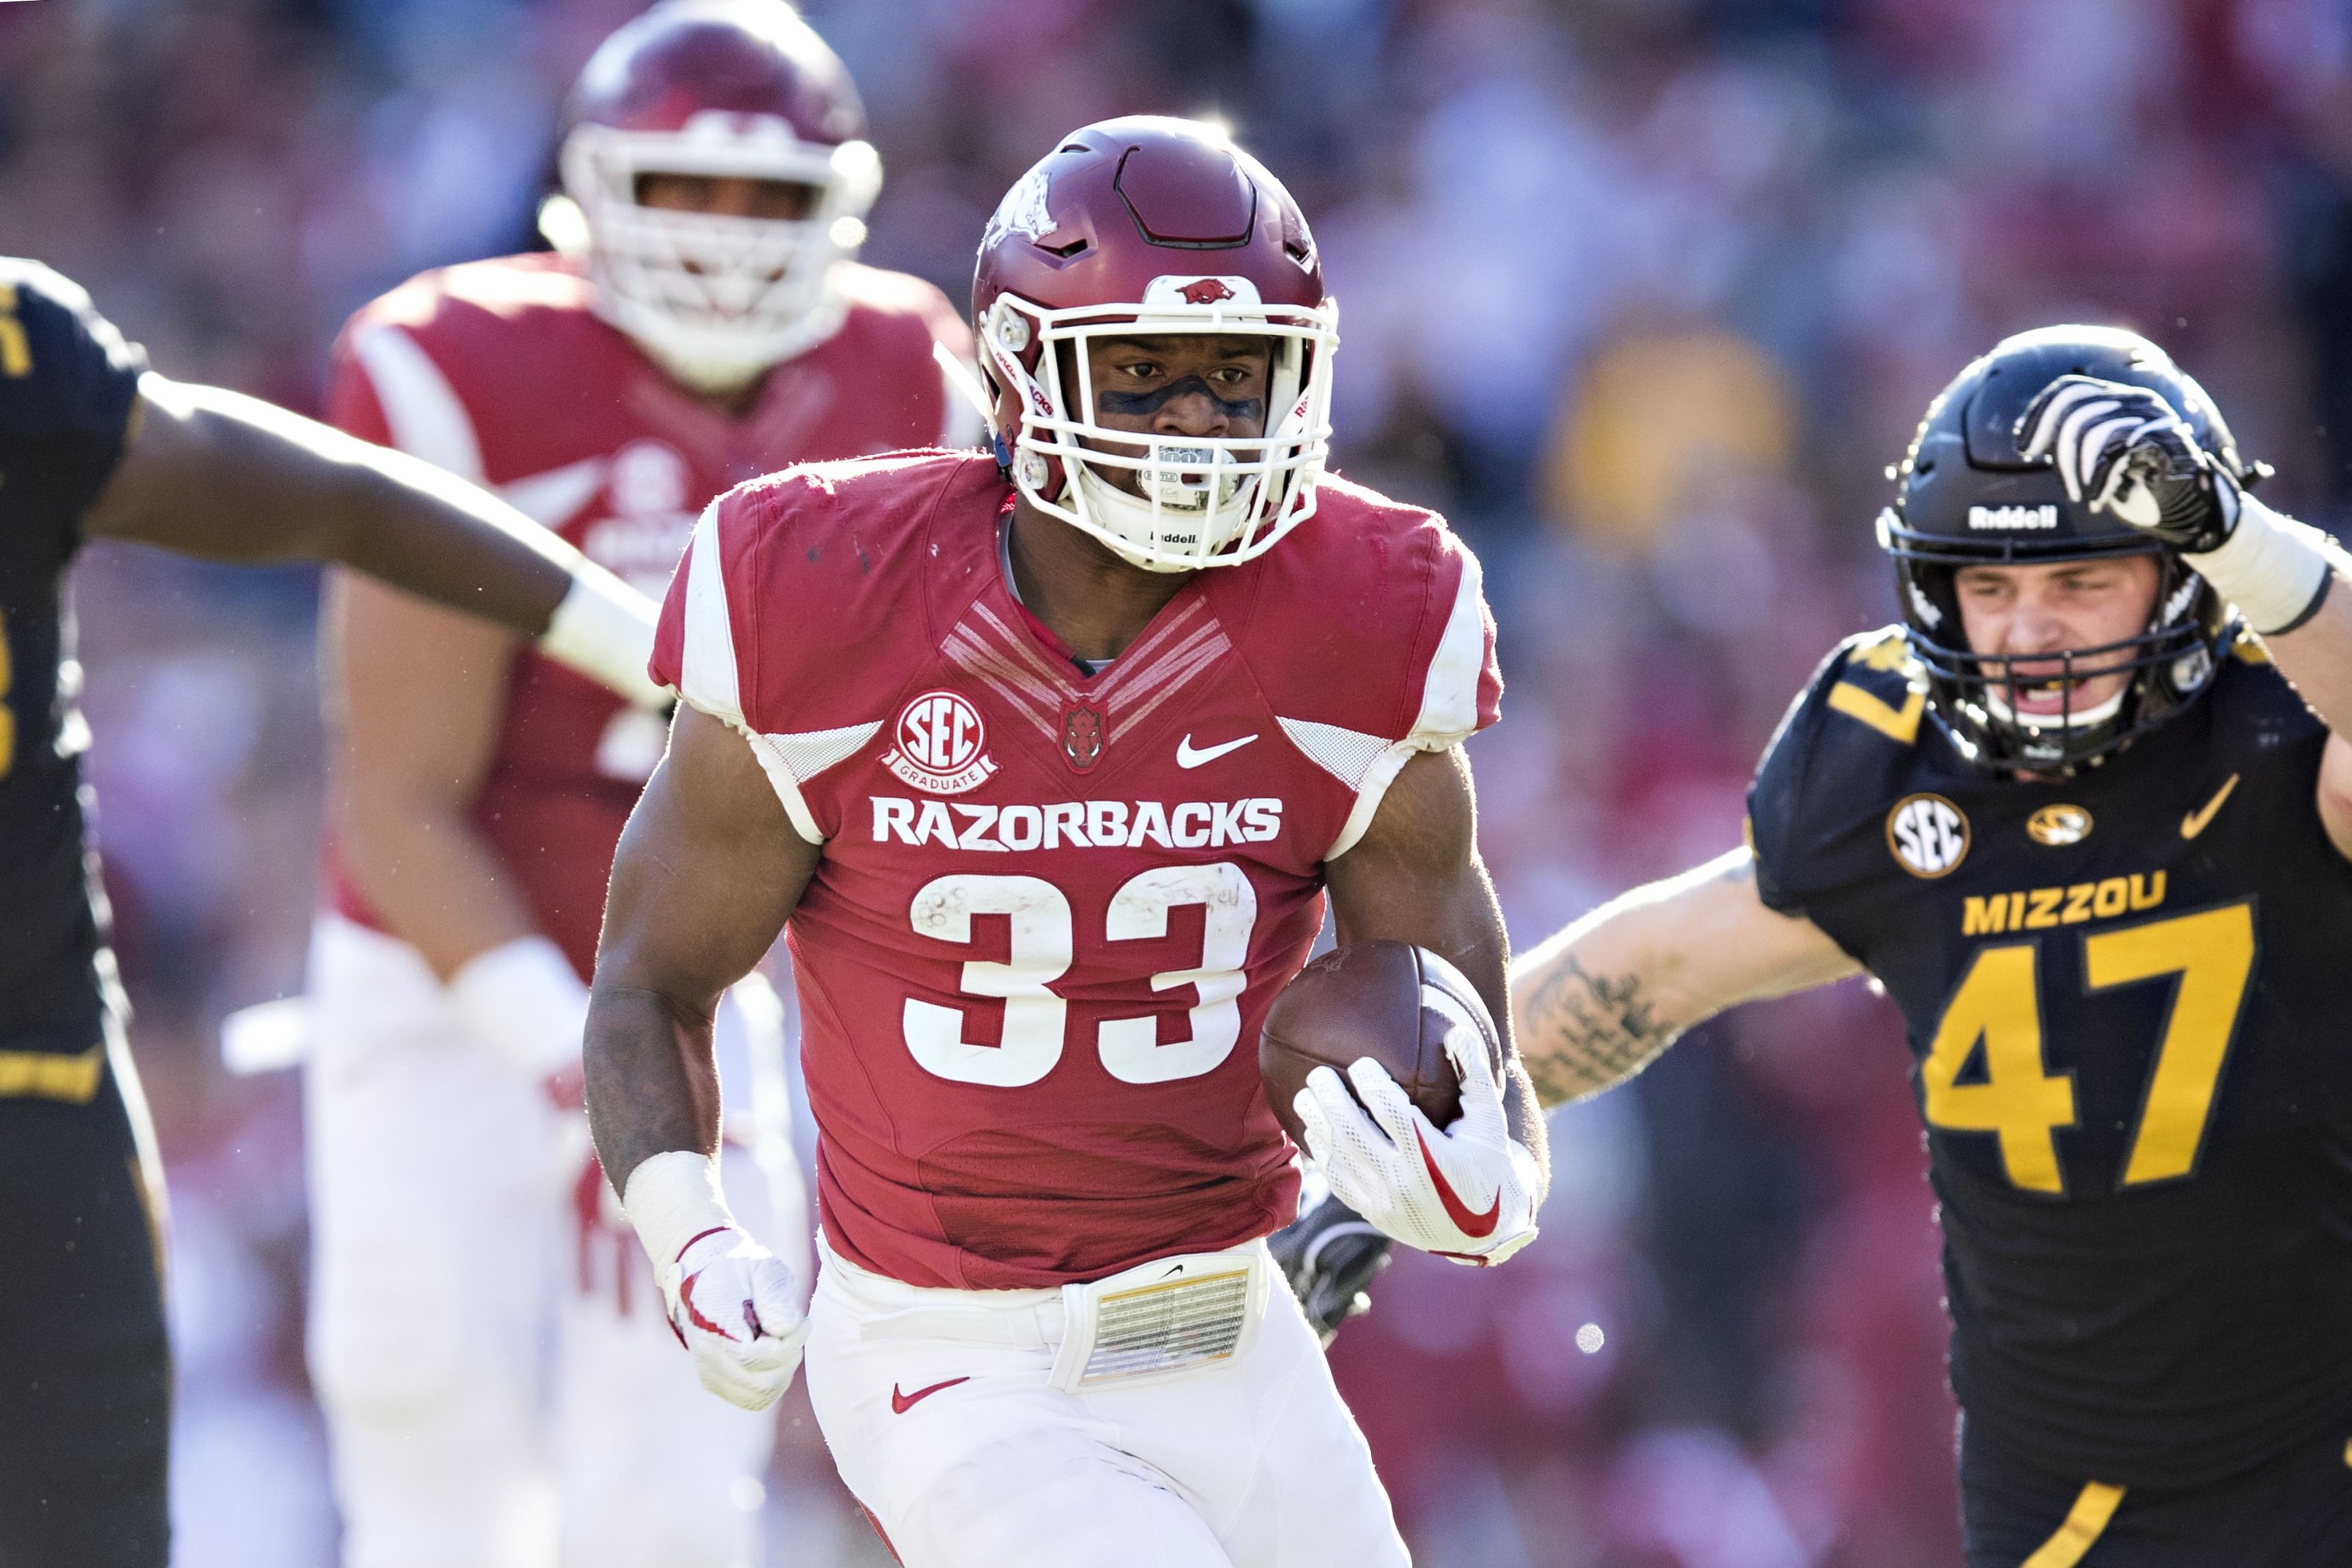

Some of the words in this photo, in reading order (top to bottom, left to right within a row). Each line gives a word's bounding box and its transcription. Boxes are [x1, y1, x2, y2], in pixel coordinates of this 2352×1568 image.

[1968, 505, 2057, 529] Riddell
[906, 698, 976, 767] SEC
[900, 765, 979, 791] GRADUATE
[869, 796, 1283, 852] RAZORBACKS
[1893, 799, 1964, 872] SEC
[1962, 870, 2168, 936] MIZZOU
[903, 861, 1258, 1087] 33
[1922, 902, 2255, 1194] 47
